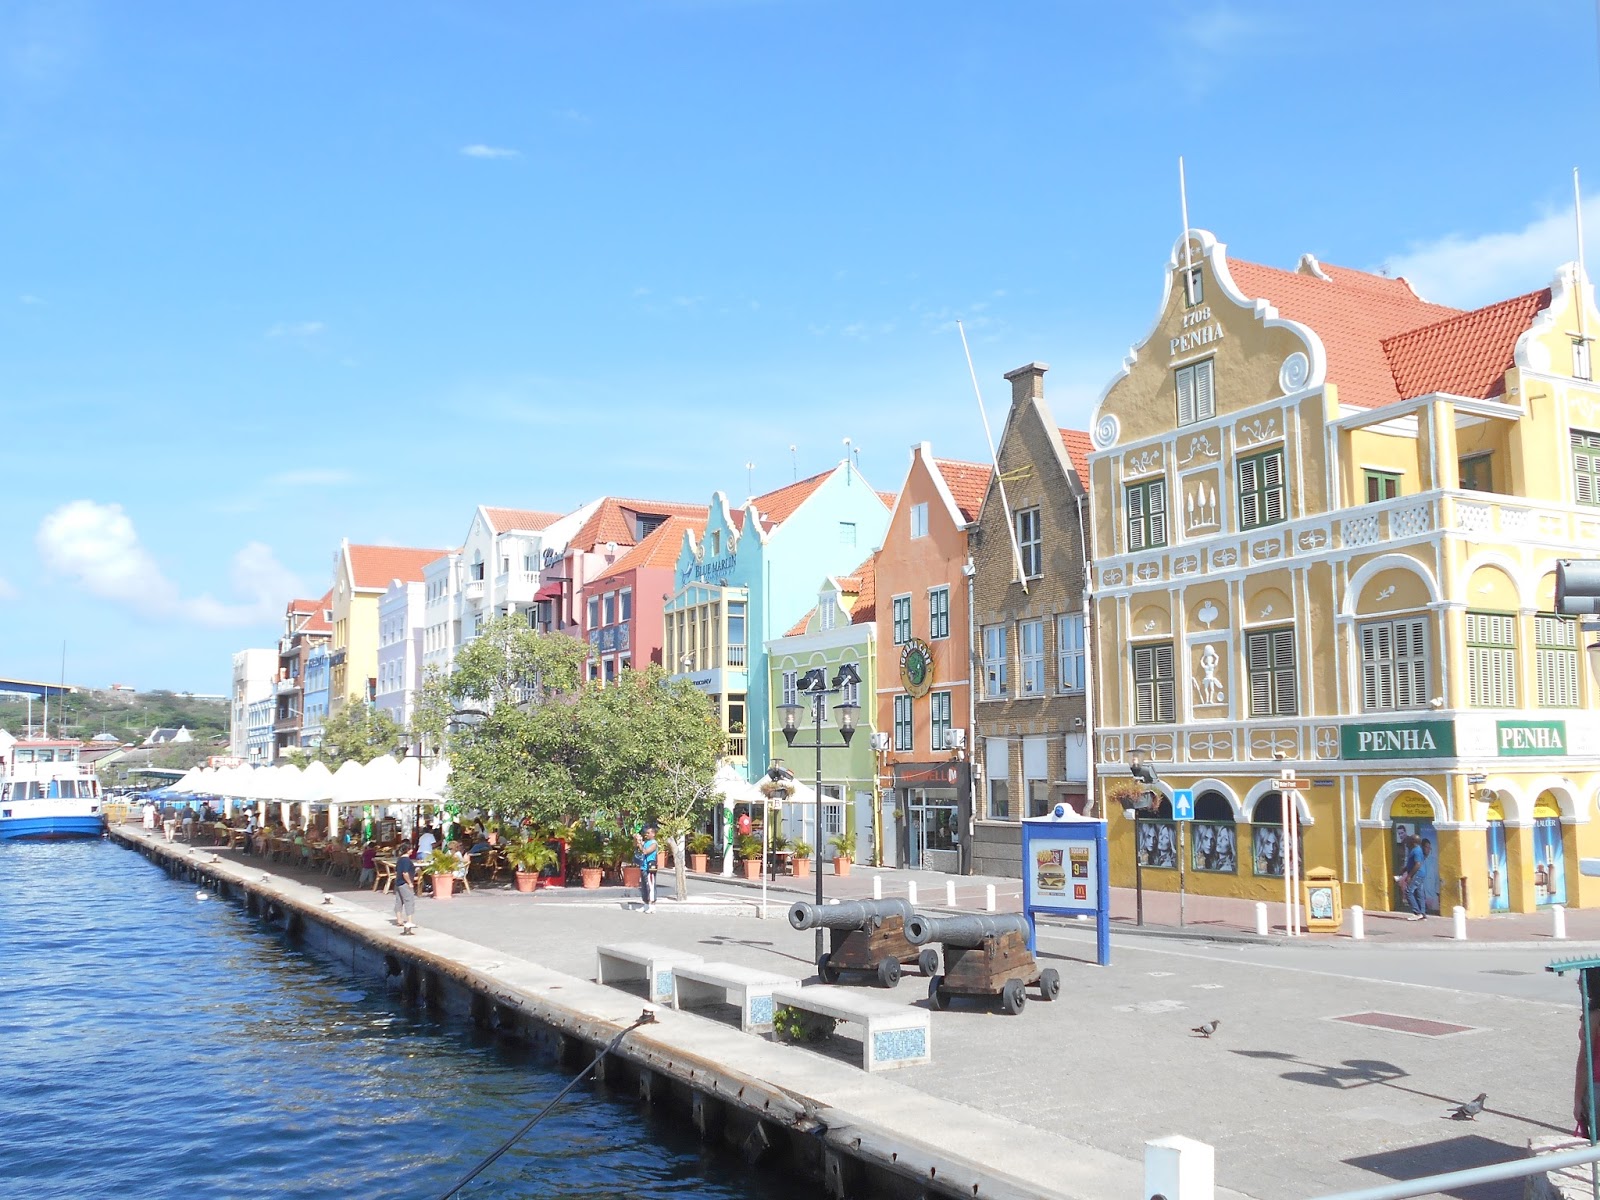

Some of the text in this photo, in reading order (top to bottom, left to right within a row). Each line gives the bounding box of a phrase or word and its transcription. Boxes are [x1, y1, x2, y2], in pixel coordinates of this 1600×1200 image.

[1183, 307, 1211, 328] 1708
[1170, 322, 1225, 356] PENHA
[695, 563, 711, 578] BLUE
[712, 554, 737, 572] MARLIN
[1358, 728, 1437, 752] PENHA
[1500, 727, 1564, 749] PENHA
[1536, 820, 1556, 828] LAUDER
